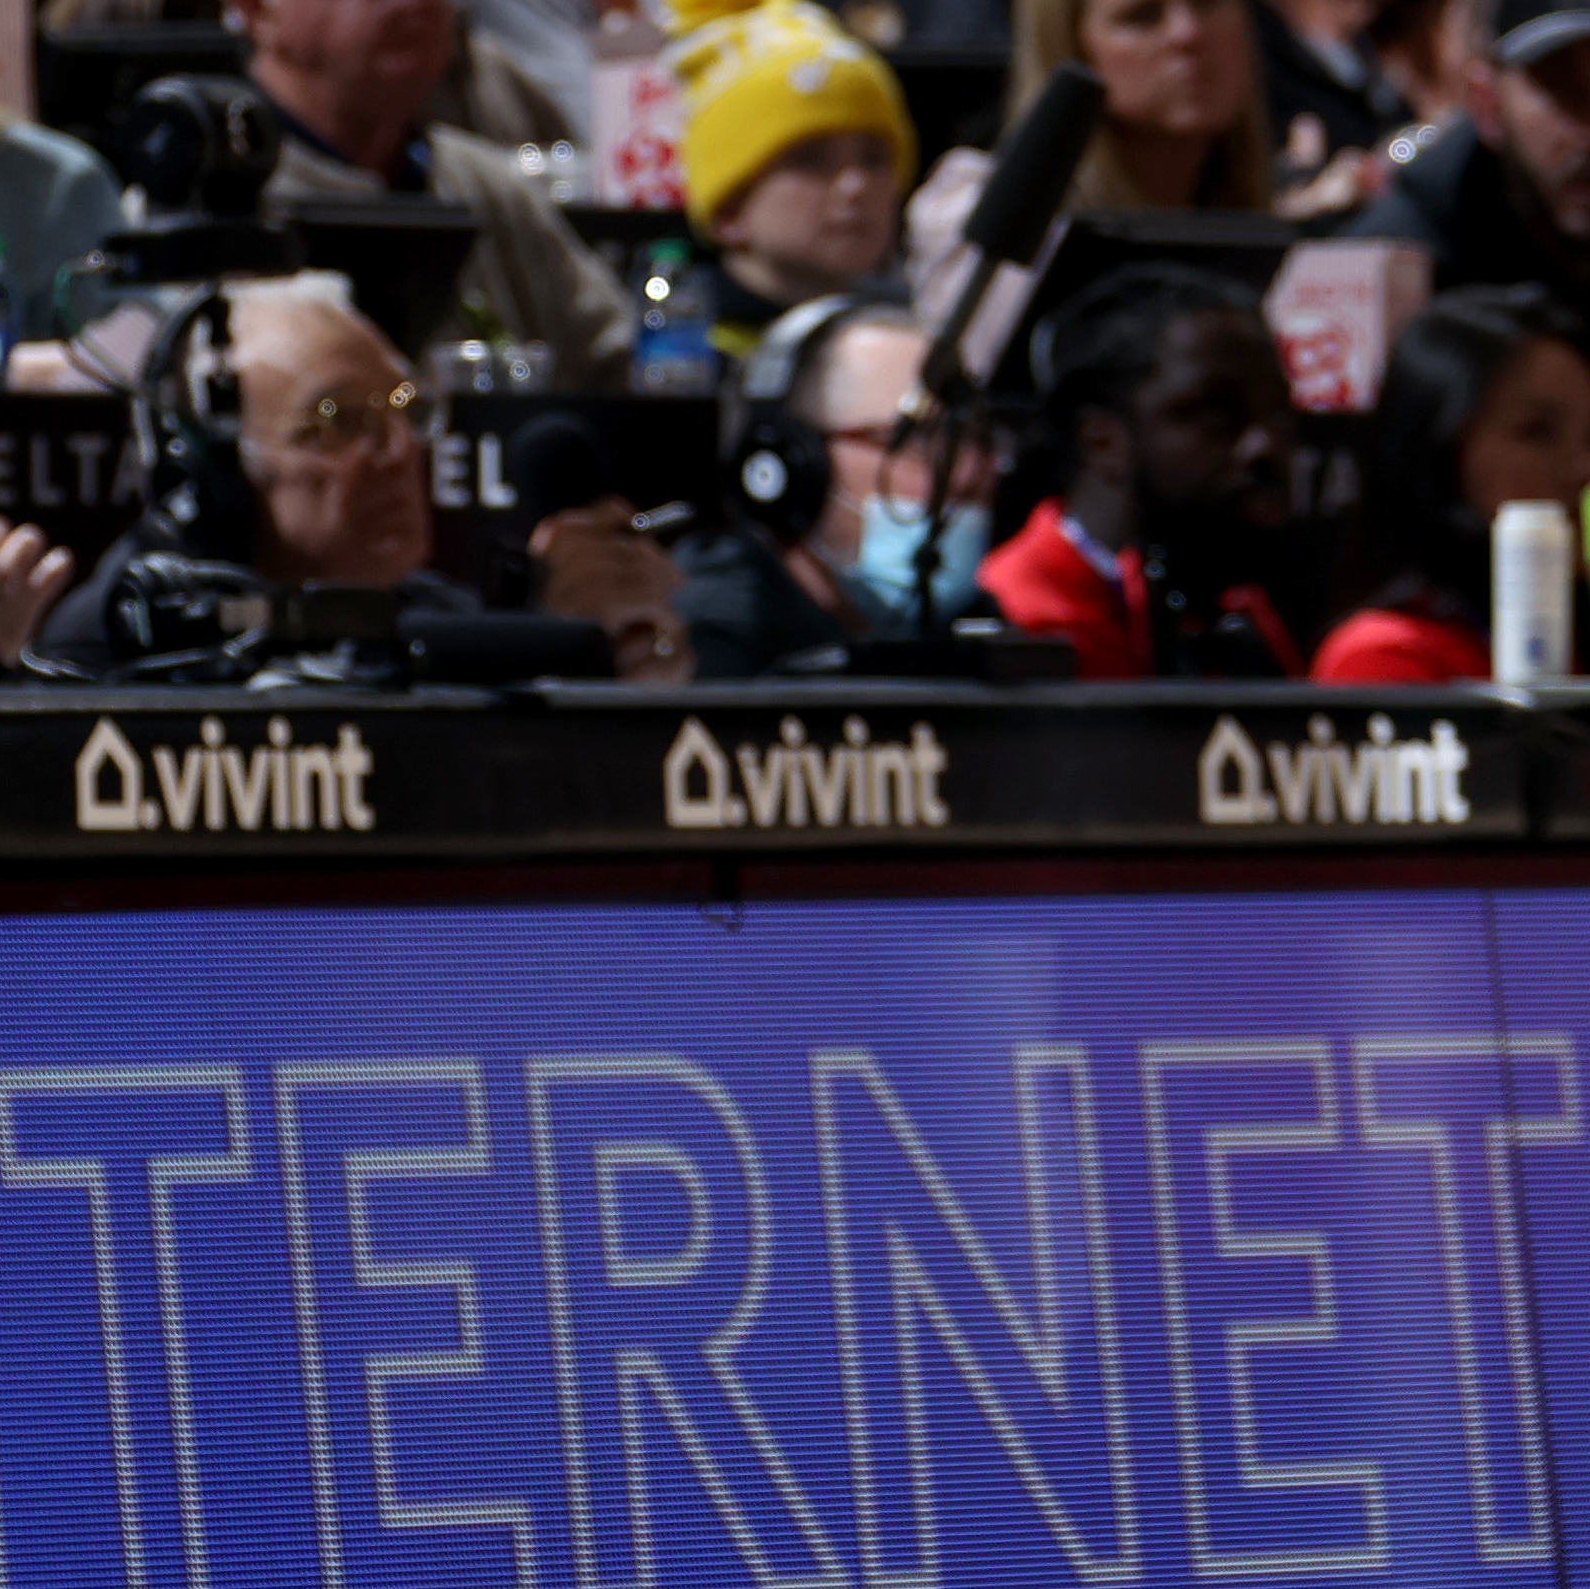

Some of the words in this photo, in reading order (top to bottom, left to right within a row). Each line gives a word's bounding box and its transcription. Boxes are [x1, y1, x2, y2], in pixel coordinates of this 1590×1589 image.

[152, 714, 376, 832] vivint
[735, 712, 950, 828] vivint
[1265, 711, 1470, 824] vivint
